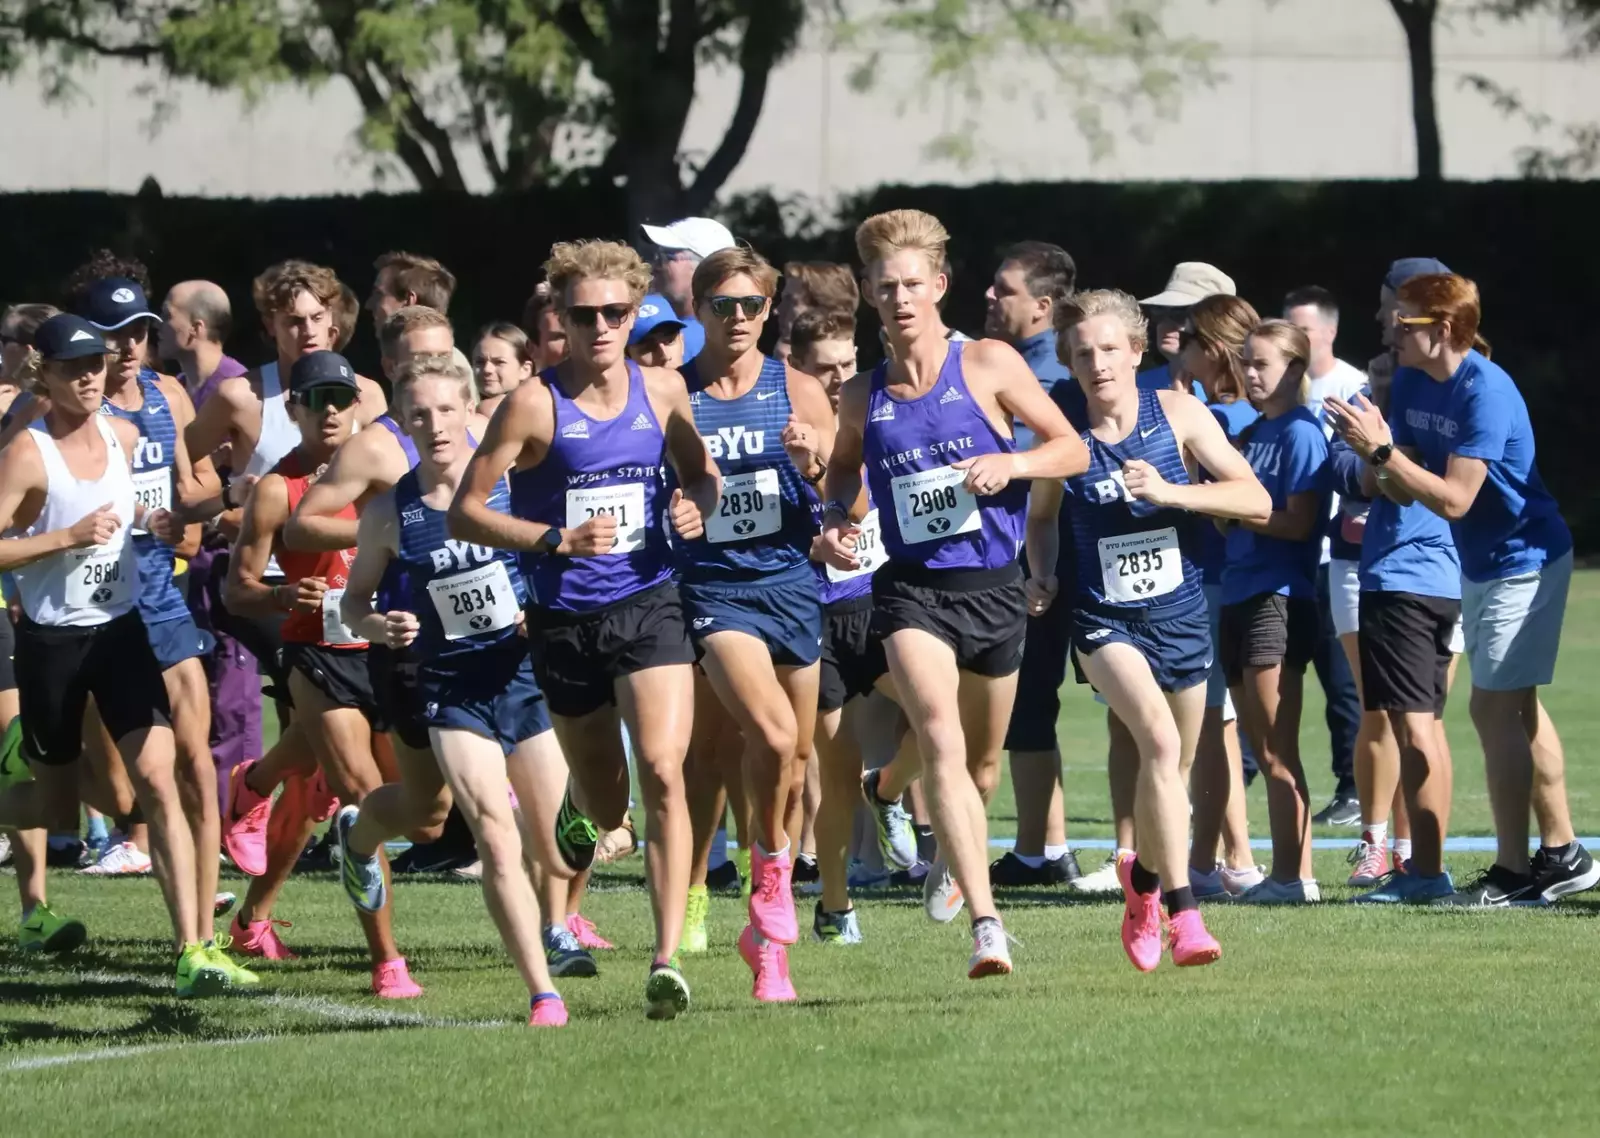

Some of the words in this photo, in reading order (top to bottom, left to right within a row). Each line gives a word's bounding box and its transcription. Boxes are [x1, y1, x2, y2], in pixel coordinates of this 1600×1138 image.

[131, 436, 163, 468] YU
[701, 425, 765, 460] BYU
[880, 448, 923, 470] WEBER
[929, 436, 974, 456] STATE
[617, 466, 656, 478] STATE
[720, 489, 764, 518] 2830
[908, 485, 957, 517] 2908
[430, 539, 494, 574] BYU
[854, 528, 876, 554] 07
[83, 560, 119, 585] 2880
[1117, 547, 1163, 577] 2835
[449, 584, 496, 615] 2834
